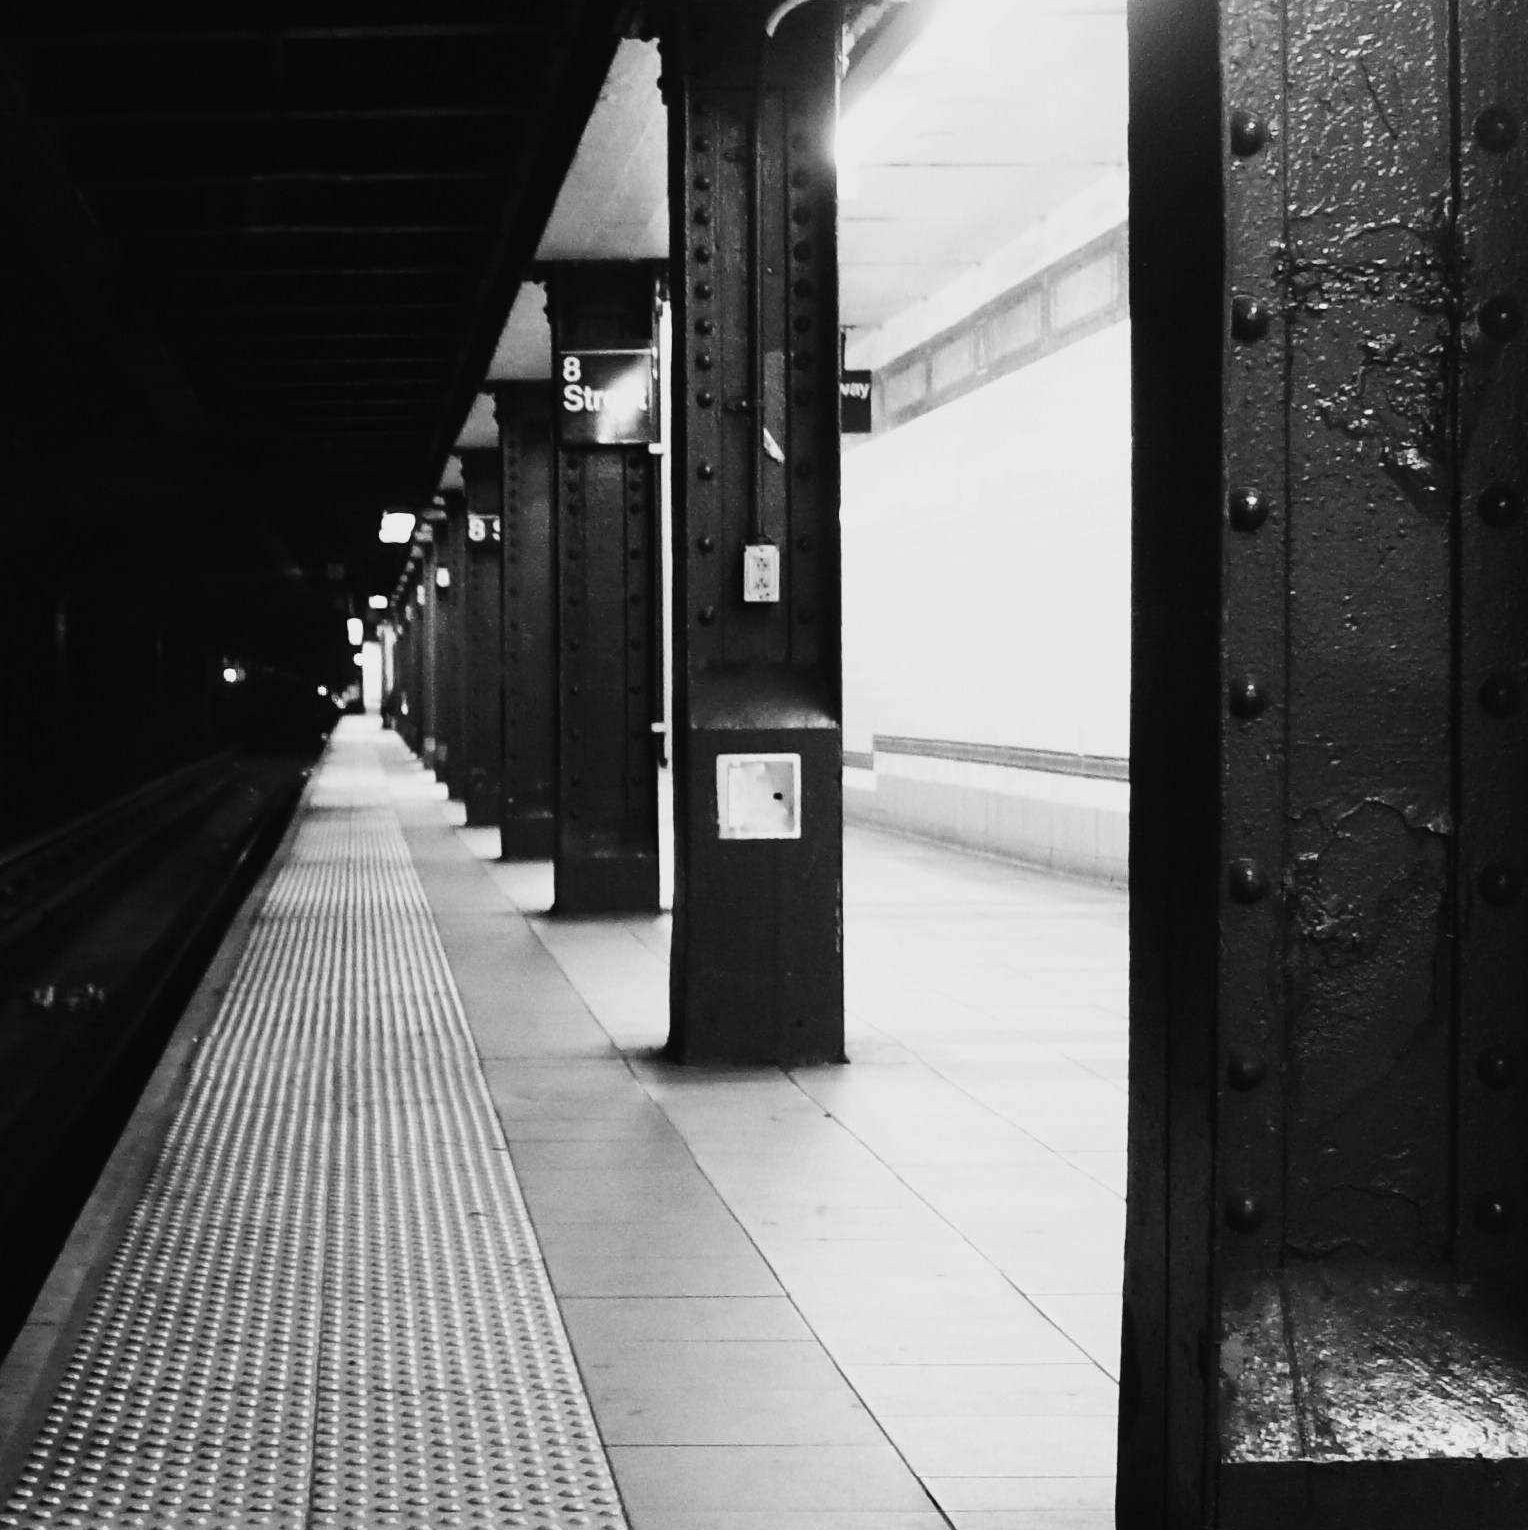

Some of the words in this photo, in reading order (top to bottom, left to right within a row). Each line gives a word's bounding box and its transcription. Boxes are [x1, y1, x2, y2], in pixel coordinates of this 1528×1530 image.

[563, 356, 581, 382] 8
[563, 384, 647, 412] Strt
[468, 518, 486, 542] 8
